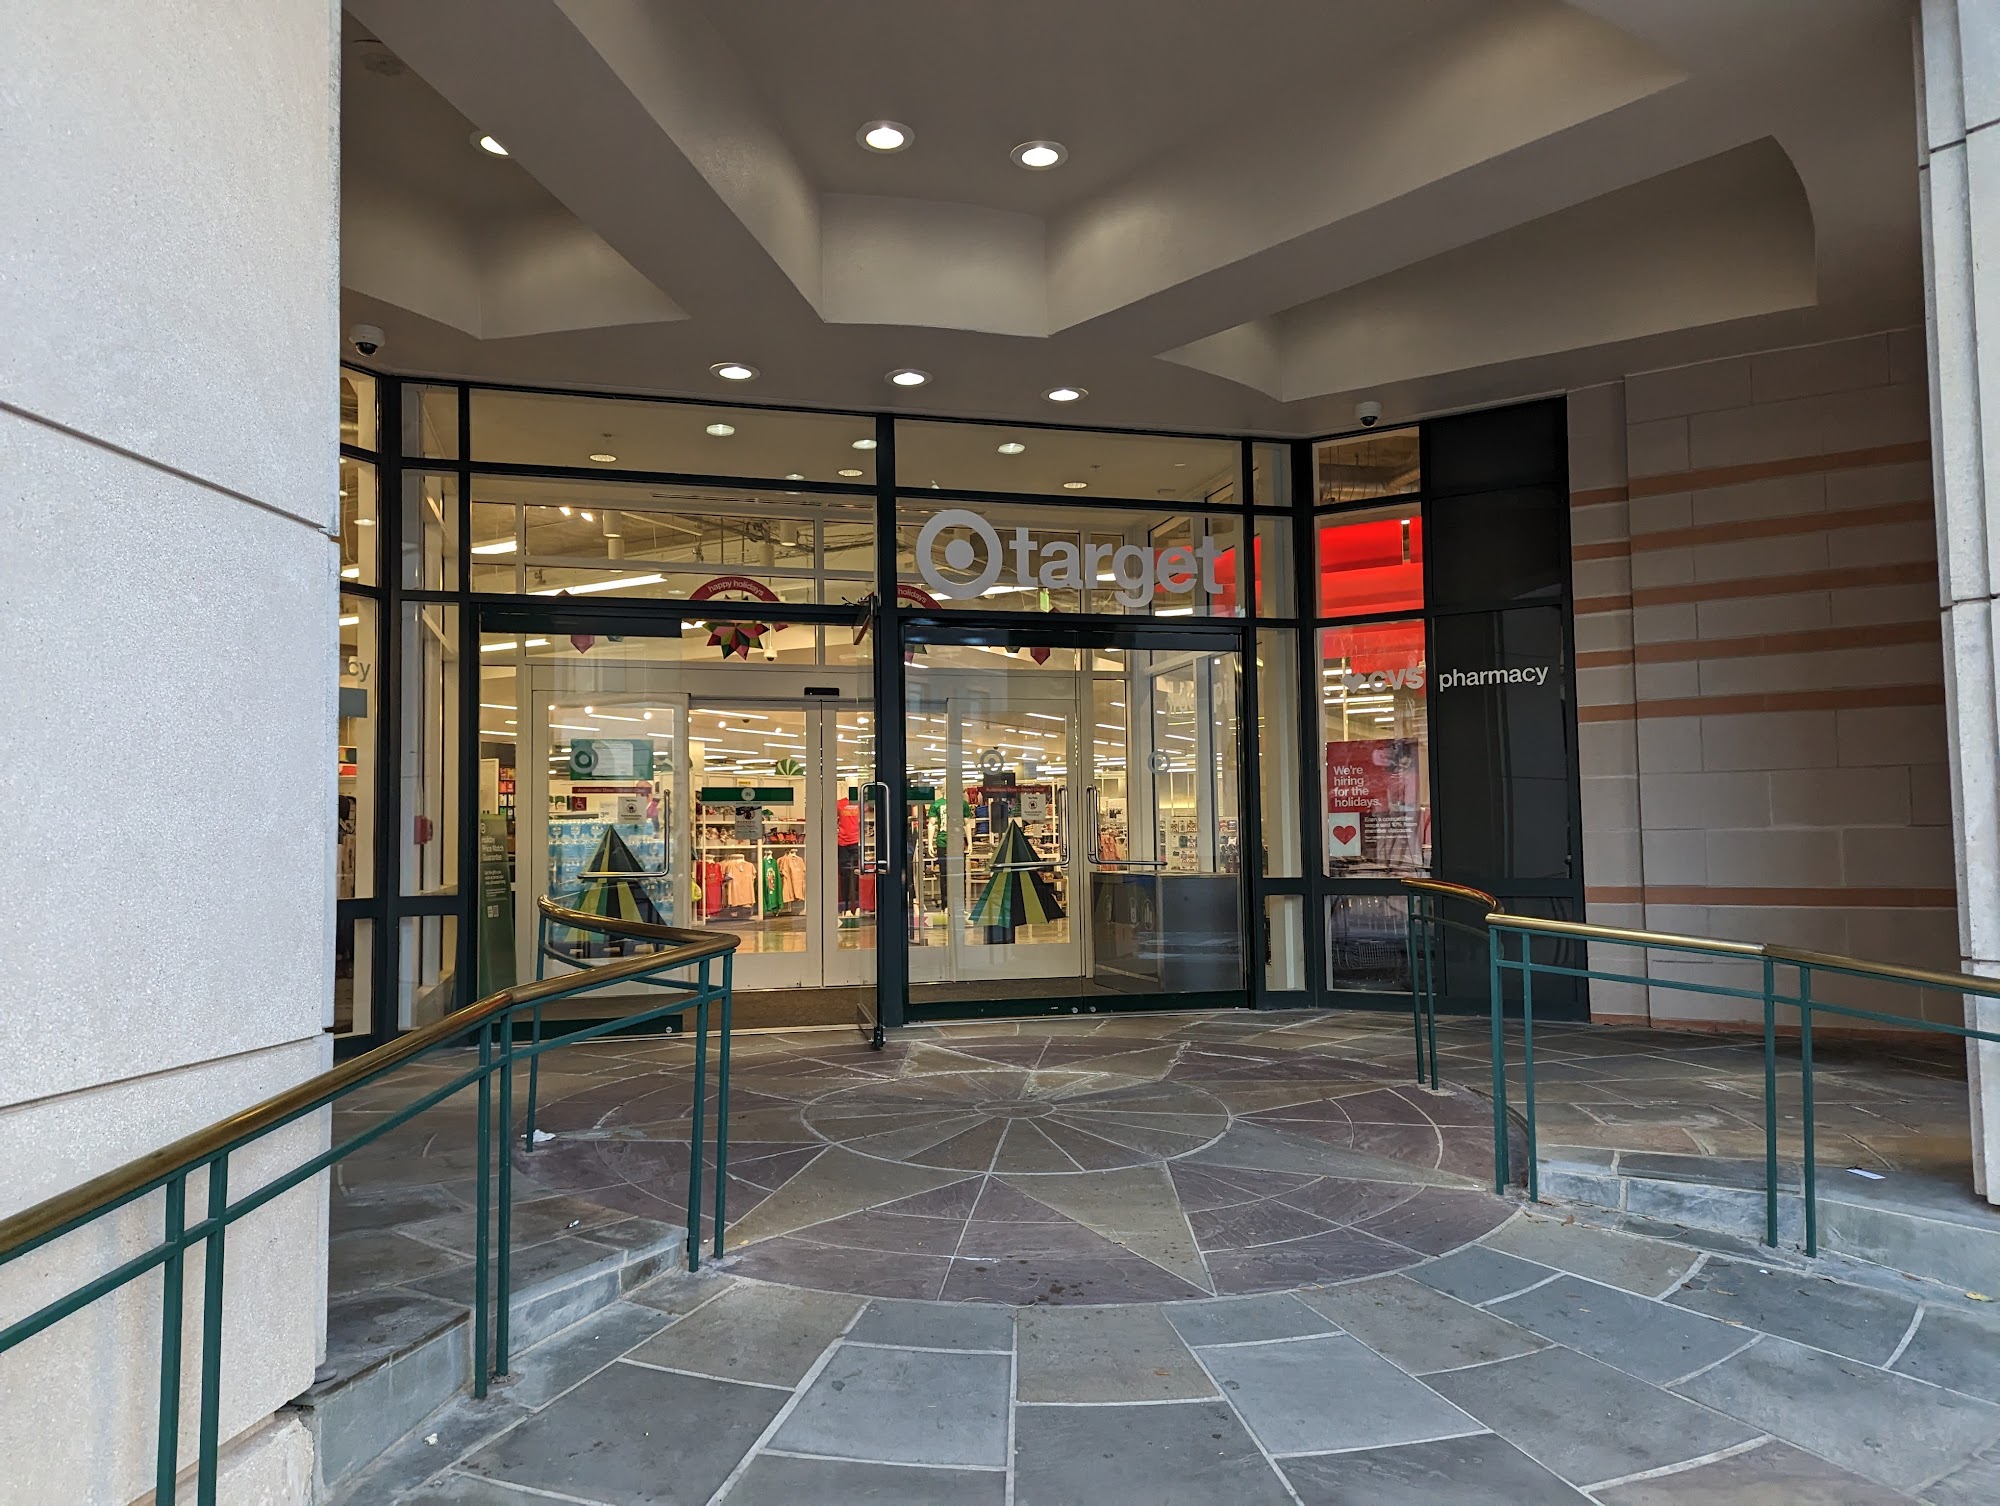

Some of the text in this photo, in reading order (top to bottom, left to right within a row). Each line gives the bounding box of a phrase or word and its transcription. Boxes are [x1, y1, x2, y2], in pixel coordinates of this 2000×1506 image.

[1009, 527, 1223, 608] target
[707, 580, 764, 596] happy holidays
[897, 588, 927, 603] holidays
[1367, 666, 1549, 692] CVS pharmacy
[1333, 765, 1364, 775] We're
[1334, 776, 1364, 787] hiring
[1334, 787, 1369, 797] for the
[1334, 797, 1382, 808] holidays.
